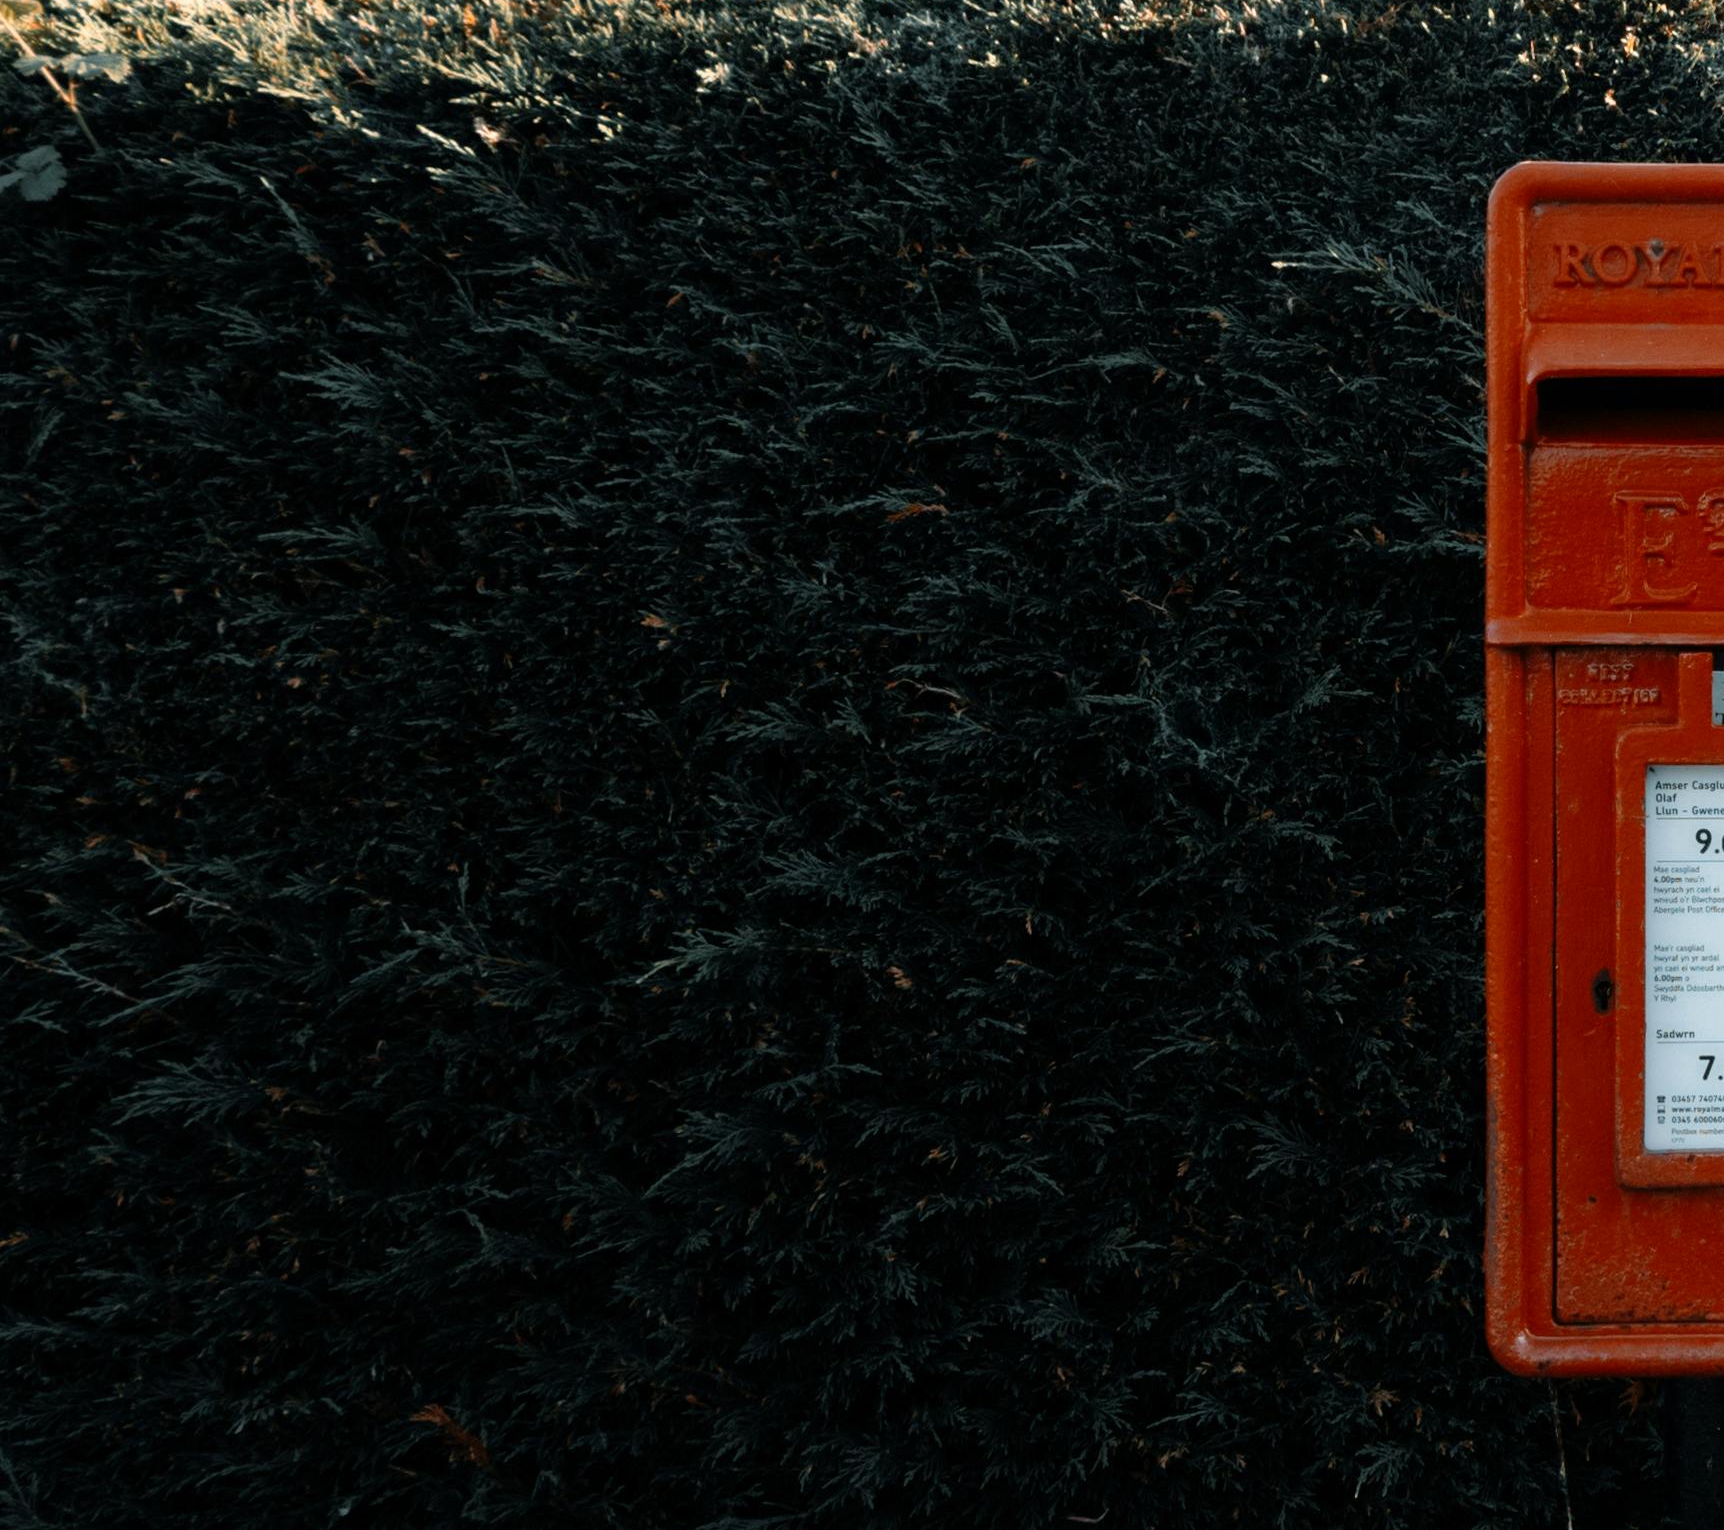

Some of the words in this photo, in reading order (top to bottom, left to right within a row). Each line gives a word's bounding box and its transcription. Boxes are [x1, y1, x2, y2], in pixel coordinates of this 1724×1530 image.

[1656, 781, 1688, 790] Amser
[1656, 793, 1677, 803] Olaf
[1656, 806, 1678, 815] Llun
[1654, 906, 1685, 914] Abergele
[1656, 1029, 1695, 1039] Sadwrn
